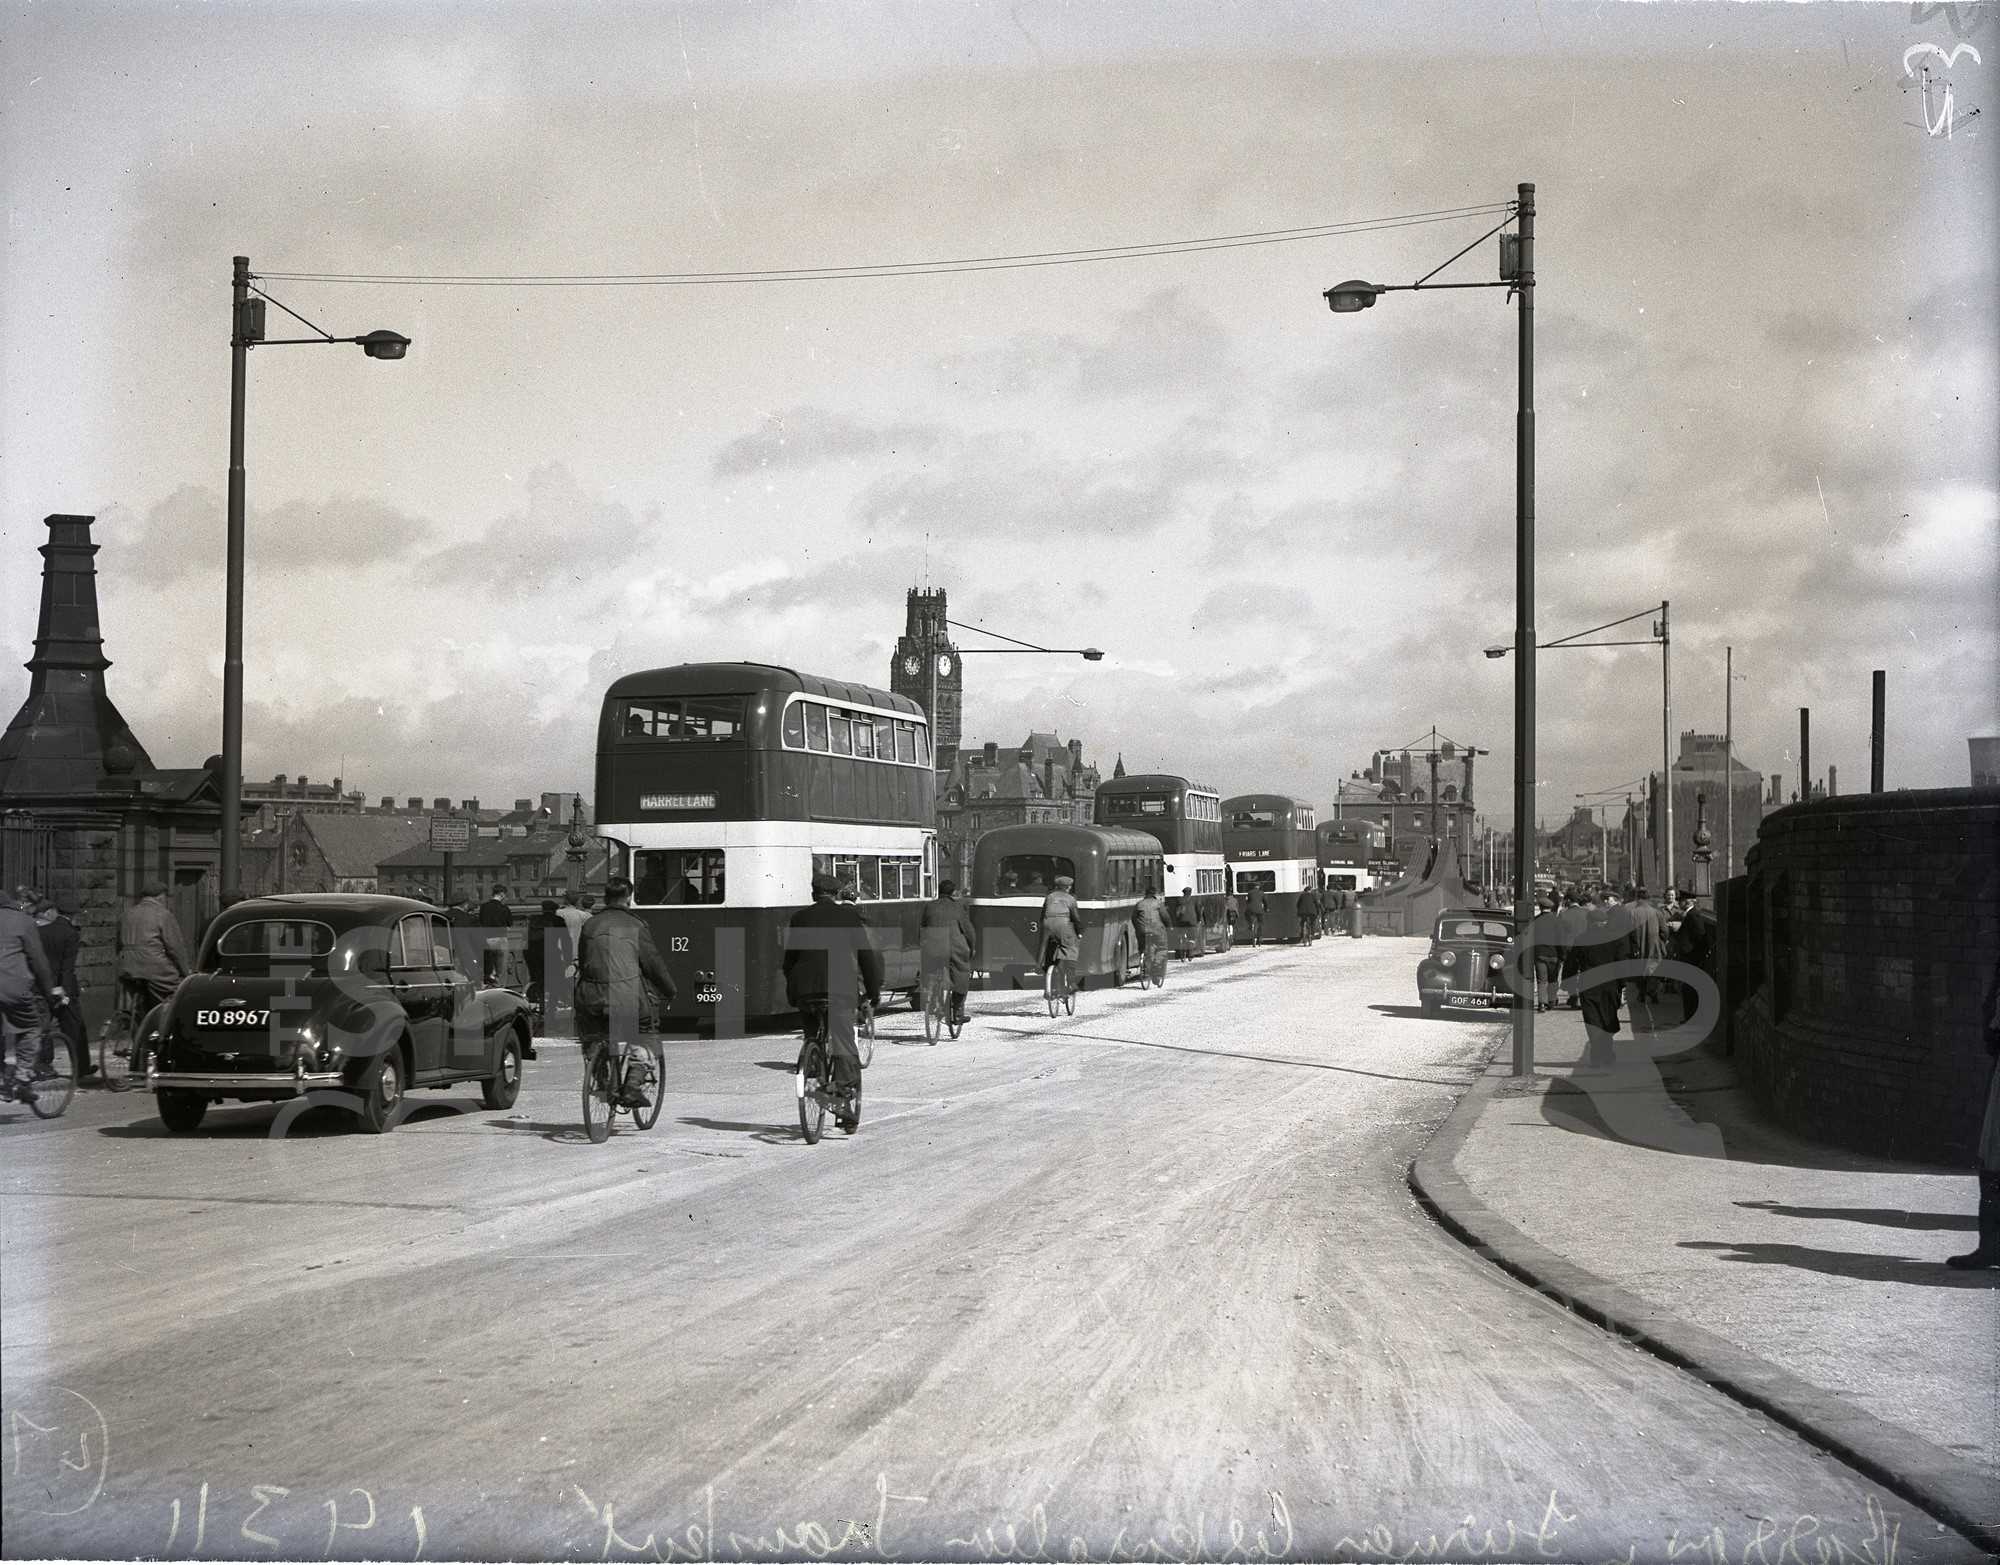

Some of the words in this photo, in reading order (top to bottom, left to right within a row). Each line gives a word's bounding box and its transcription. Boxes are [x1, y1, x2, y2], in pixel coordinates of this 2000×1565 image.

[642, 794, 684, 808] HARREL
[687, 794, 716, 808] LANE
[671, 936, 689, 952] 132
[696, 993, 723, 1003] 9059
[1470, 997, 1488, 1006] 464
[223, 1010, 271, 1025] 8967
